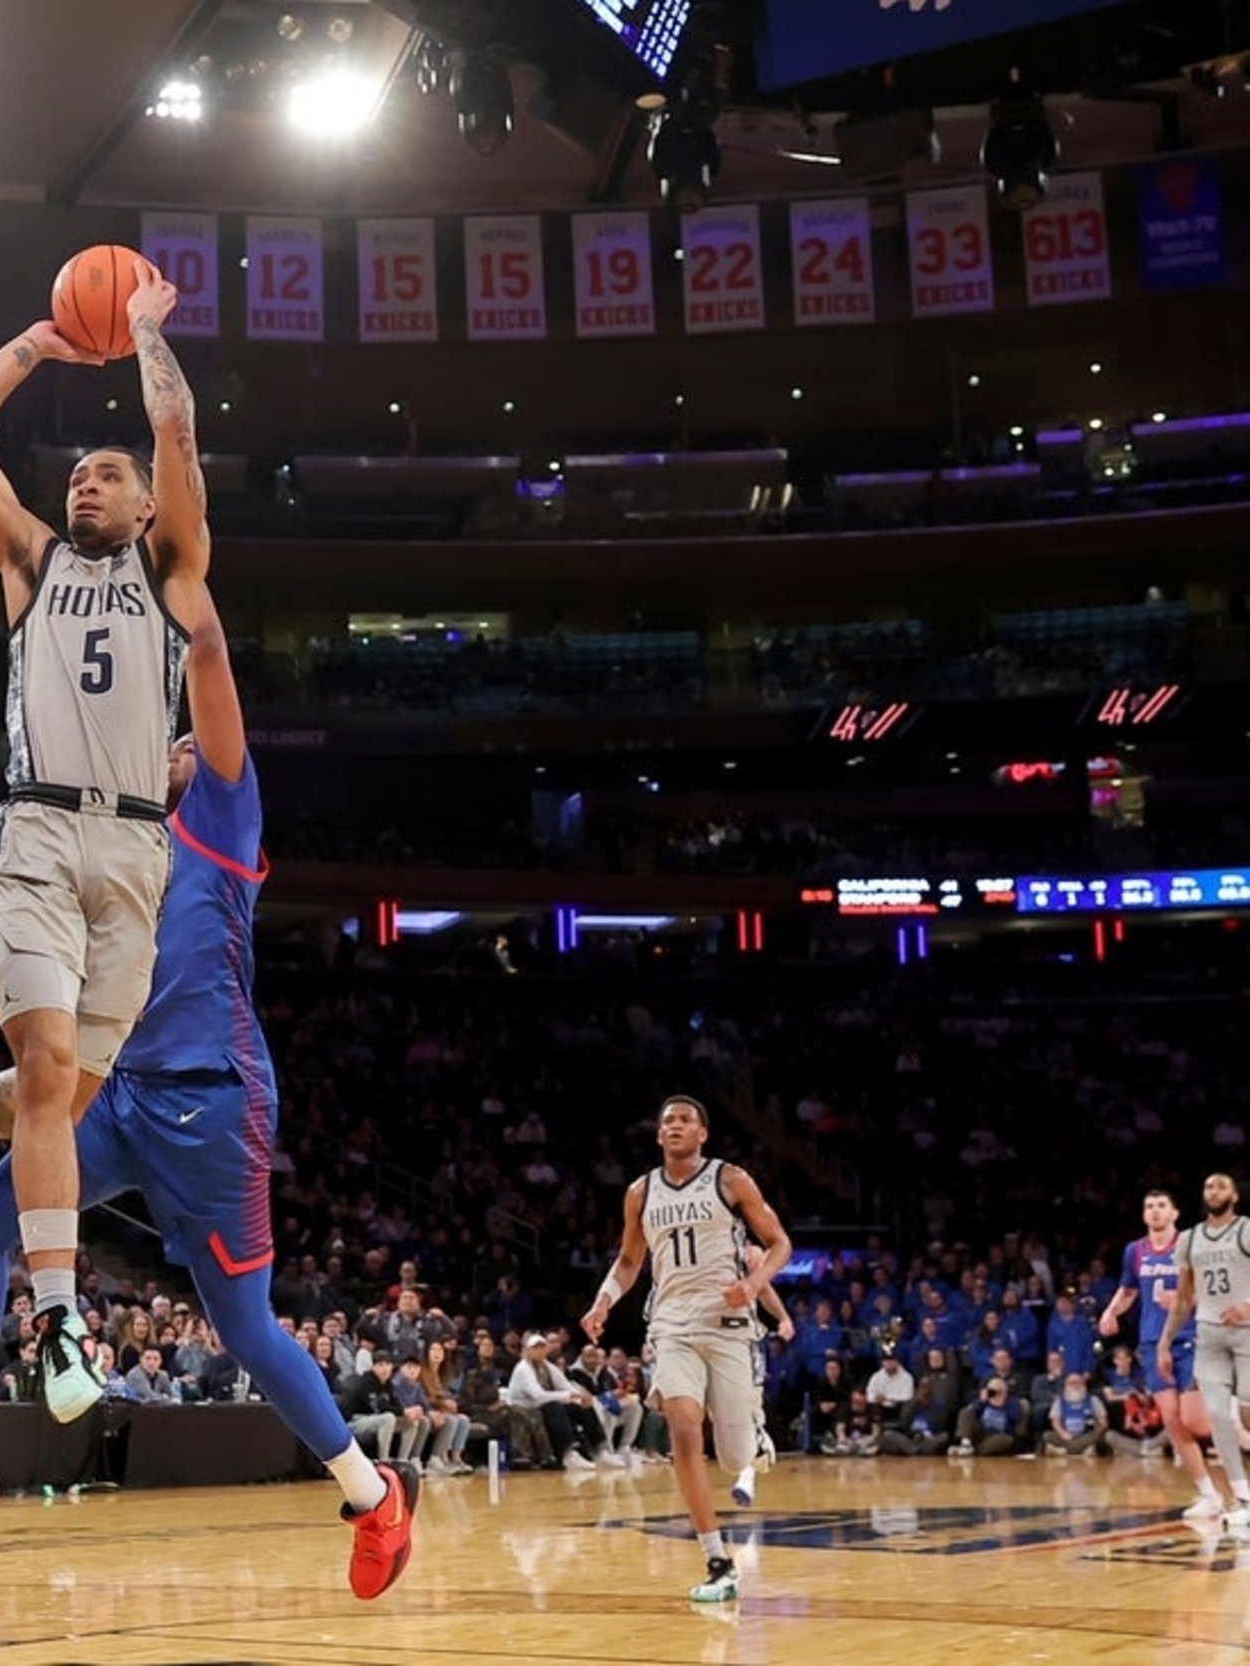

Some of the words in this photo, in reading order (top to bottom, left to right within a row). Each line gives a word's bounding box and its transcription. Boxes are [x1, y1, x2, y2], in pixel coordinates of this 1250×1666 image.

[916, 225, 983, 274] 33
[1027, 211, 1104, 263] 613
[260, 253, 309, 300] 12
[480, 251, 531, 299] 15
[587, 248, 639, 297] 19
[690, 243, 755, 292] 22
[800, 236, 864, 285] 24
[372, 255, 423, 302] 15
[916, 280, 989, 308] KNICKS
[1031, 268, 1106, 296] KNICKS
[251, 309, 320, 330] KNICKS
[472, 308, 542, 329] KNICKS
[580, 305, 650, 328] KNICKS
[690, 299, 760, 324] KNICKS
[799, 292, 871, 316] KNICKS
[364, 311, 434, 333] KNICKS
[80, 627, 113, 694] 5
[650, 1200, 713, 1229] HOYAS
[668, 1227, 697, 1268] 11
[1204, 1268, 1231, 1297] 23
